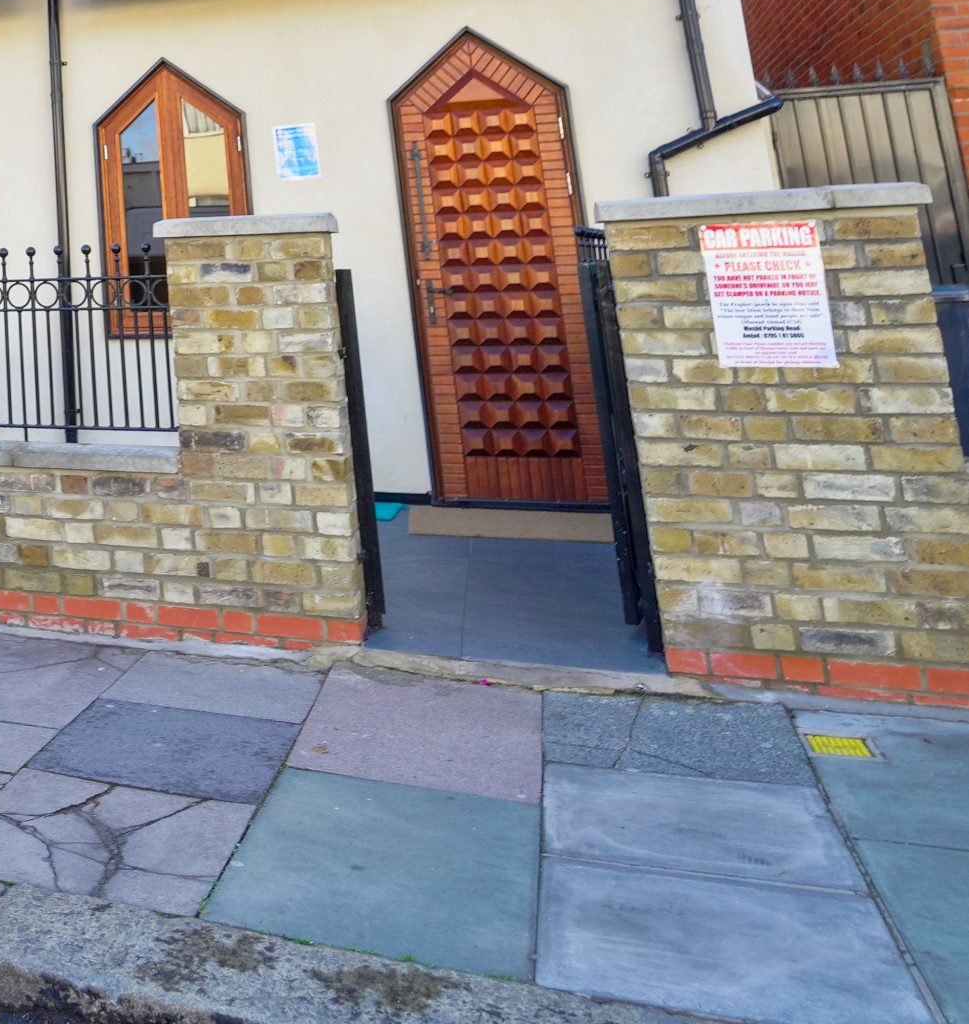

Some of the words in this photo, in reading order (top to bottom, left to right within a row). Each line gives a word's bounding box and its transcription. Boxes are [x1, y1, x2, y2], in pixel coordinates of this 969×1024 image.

[704, 228, 738, 248] CAR
[739, 226, 812, 247] PARKING
[724, 261, 762, 271] PLEASE
[764, 260, 801, 271] CHECK
